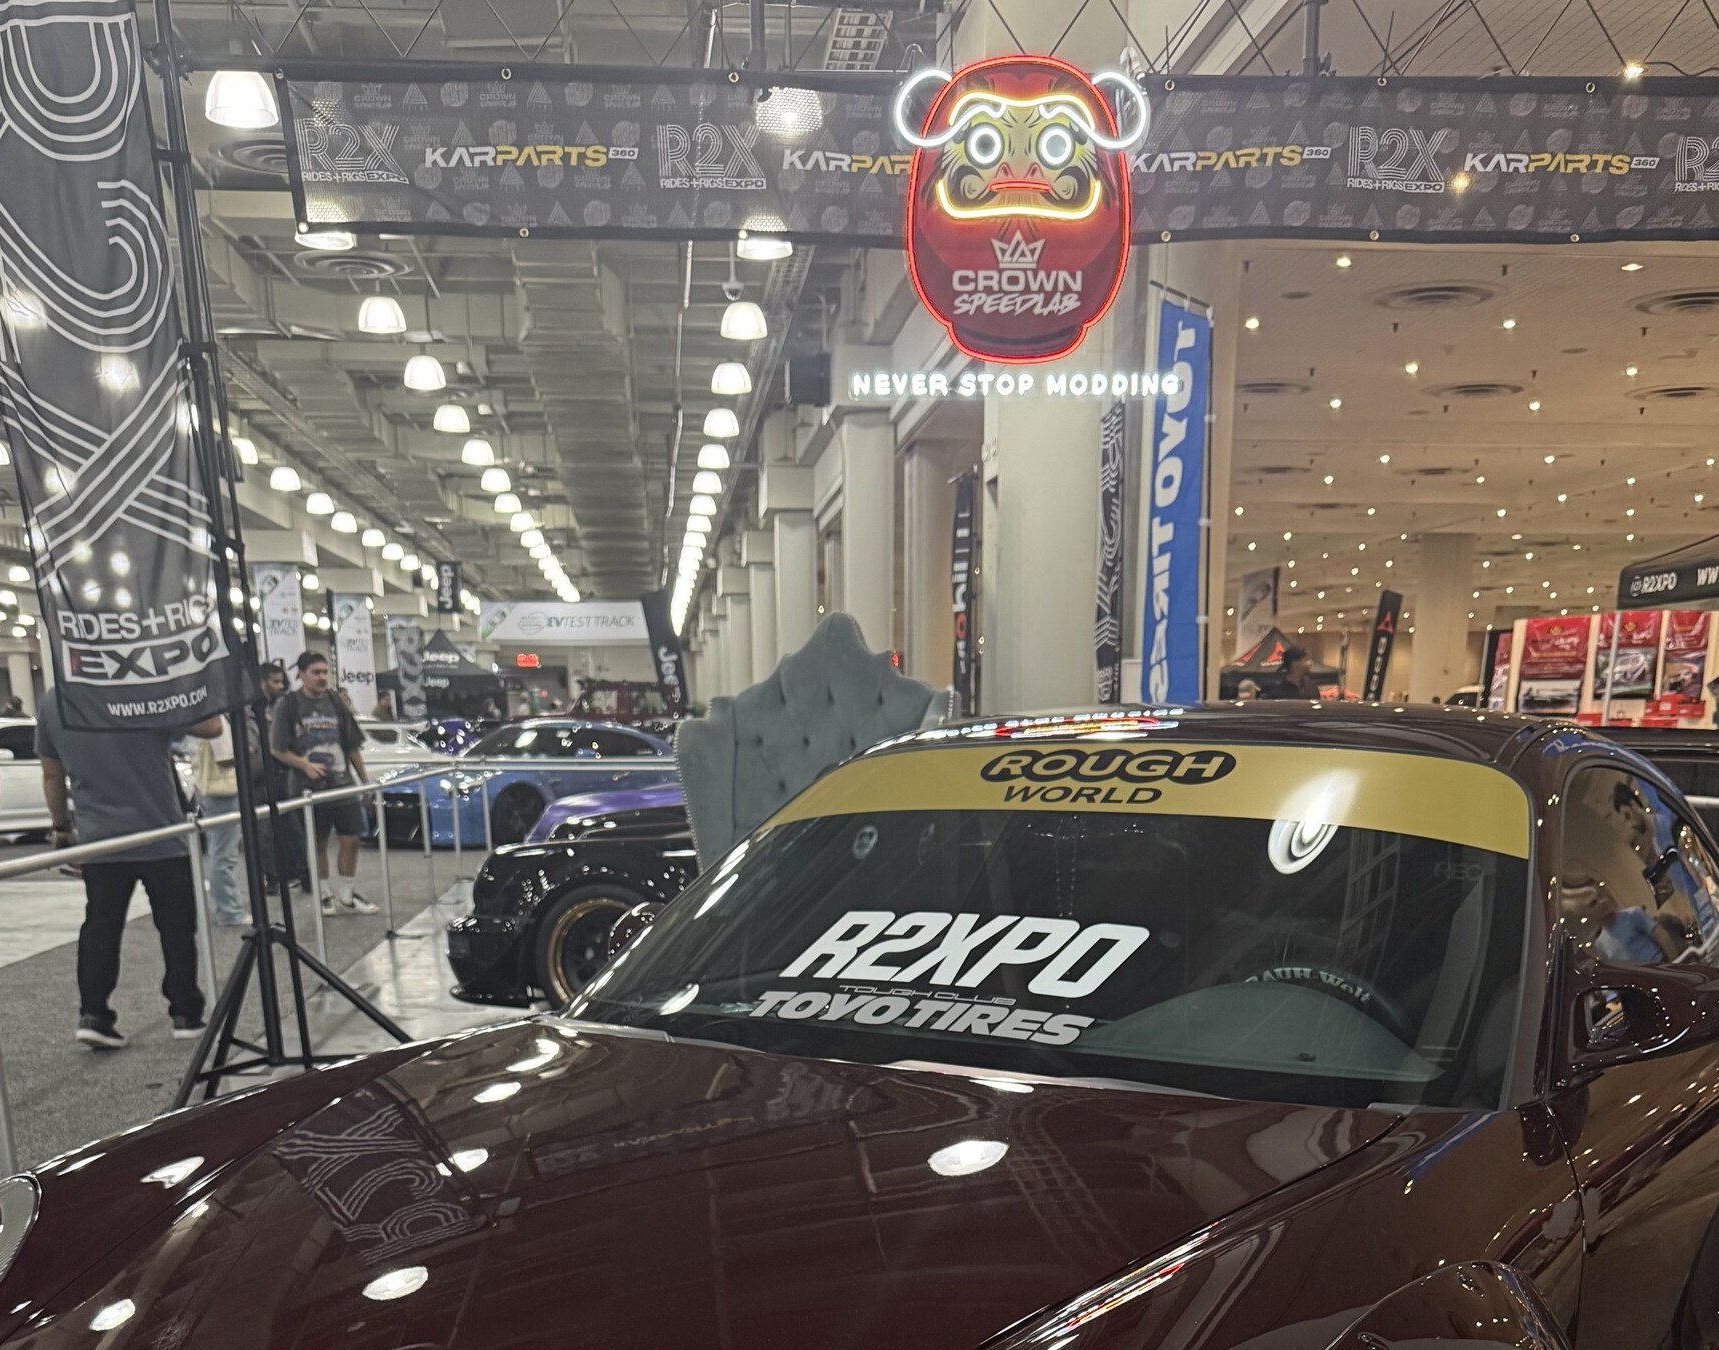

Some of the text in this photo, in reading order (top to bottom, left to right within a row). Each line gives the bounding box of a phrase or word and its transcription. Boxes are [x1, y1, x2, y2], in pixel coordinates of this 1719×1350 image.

[294, 118, 405, 177] R2X
[425, 145, 637, 168] KARPARTS 360
[657, 123, 766, 178] R2X
[1131, 145, 1330, 173] KARPARTS 360
[1347, 126, 1448, 181] R2X
[782, 150, 914, 175] KARPAR
[1464, 152, 1658, 175] KARPARTS 360
[724, 178, 766, 190] EXPO
[1404, 181, 1444, 193] EXPO
[951, 269, 1083, 292] CROWN
[952, 291, 1082, 316] SPEEDLAB
[851, 373, 1181, 396] NEVER STOP MODDING
[68, 626, 220, 680] EXPO
[340, 667, 374, 685] Jeep
[987, 754, 1225, 779] ROUGH
[1003, 786, 1163, 804] WORLD
[779, 911, 1151, 999] R2XPO
[839, 985, 1018, 1006] TOUGH CLUB
[748, 990, 1096, 1047] TOYO TIRES
